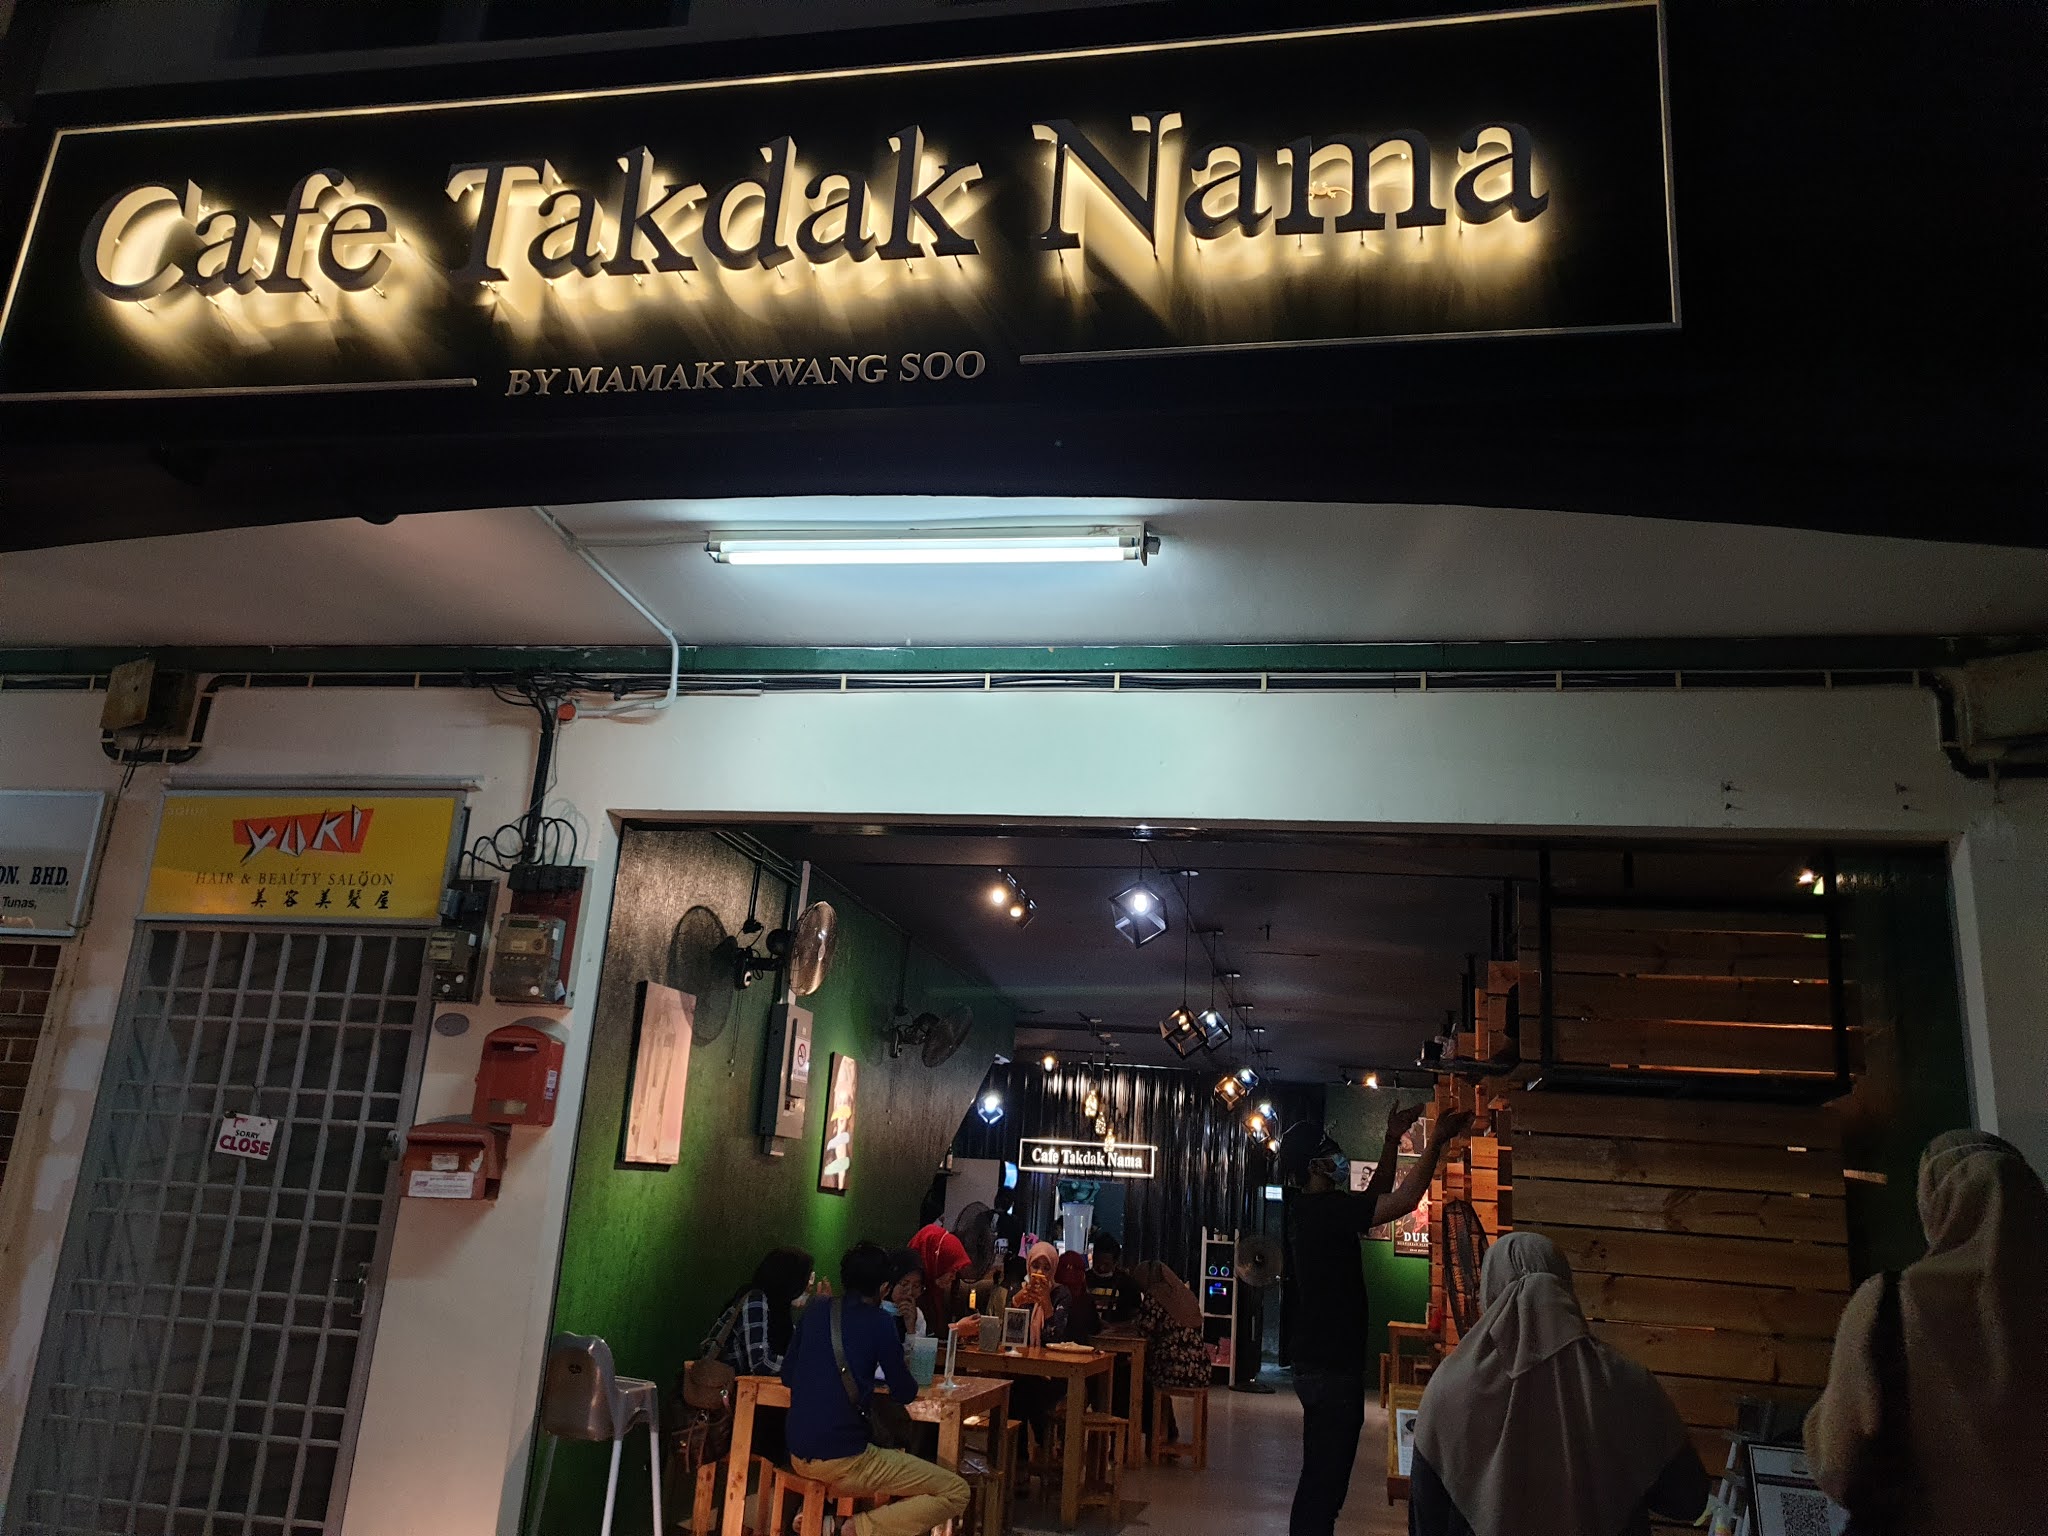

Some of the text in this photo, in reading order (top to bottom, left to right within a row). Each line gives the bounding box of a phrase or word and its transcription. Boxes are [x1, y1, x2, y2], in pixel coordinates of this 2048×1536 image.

[80, 111, 1550, 303] Cafe Takdak Nama
[504, 350, 986, 397] BY MAMAK KWANG SOO
[30, 866, 69, 886] BHD.
[195, 871, 234, 885] HAIR
[241, 871, 252, 885] &
[2, 895, 37, 910] Tunas,
[235, 1129, 260, 1140] SORRY
[219, 1134, 271, 1157] CLOSE
[1031, 1147, 1143, 1169] Cafe Takdak Nama
